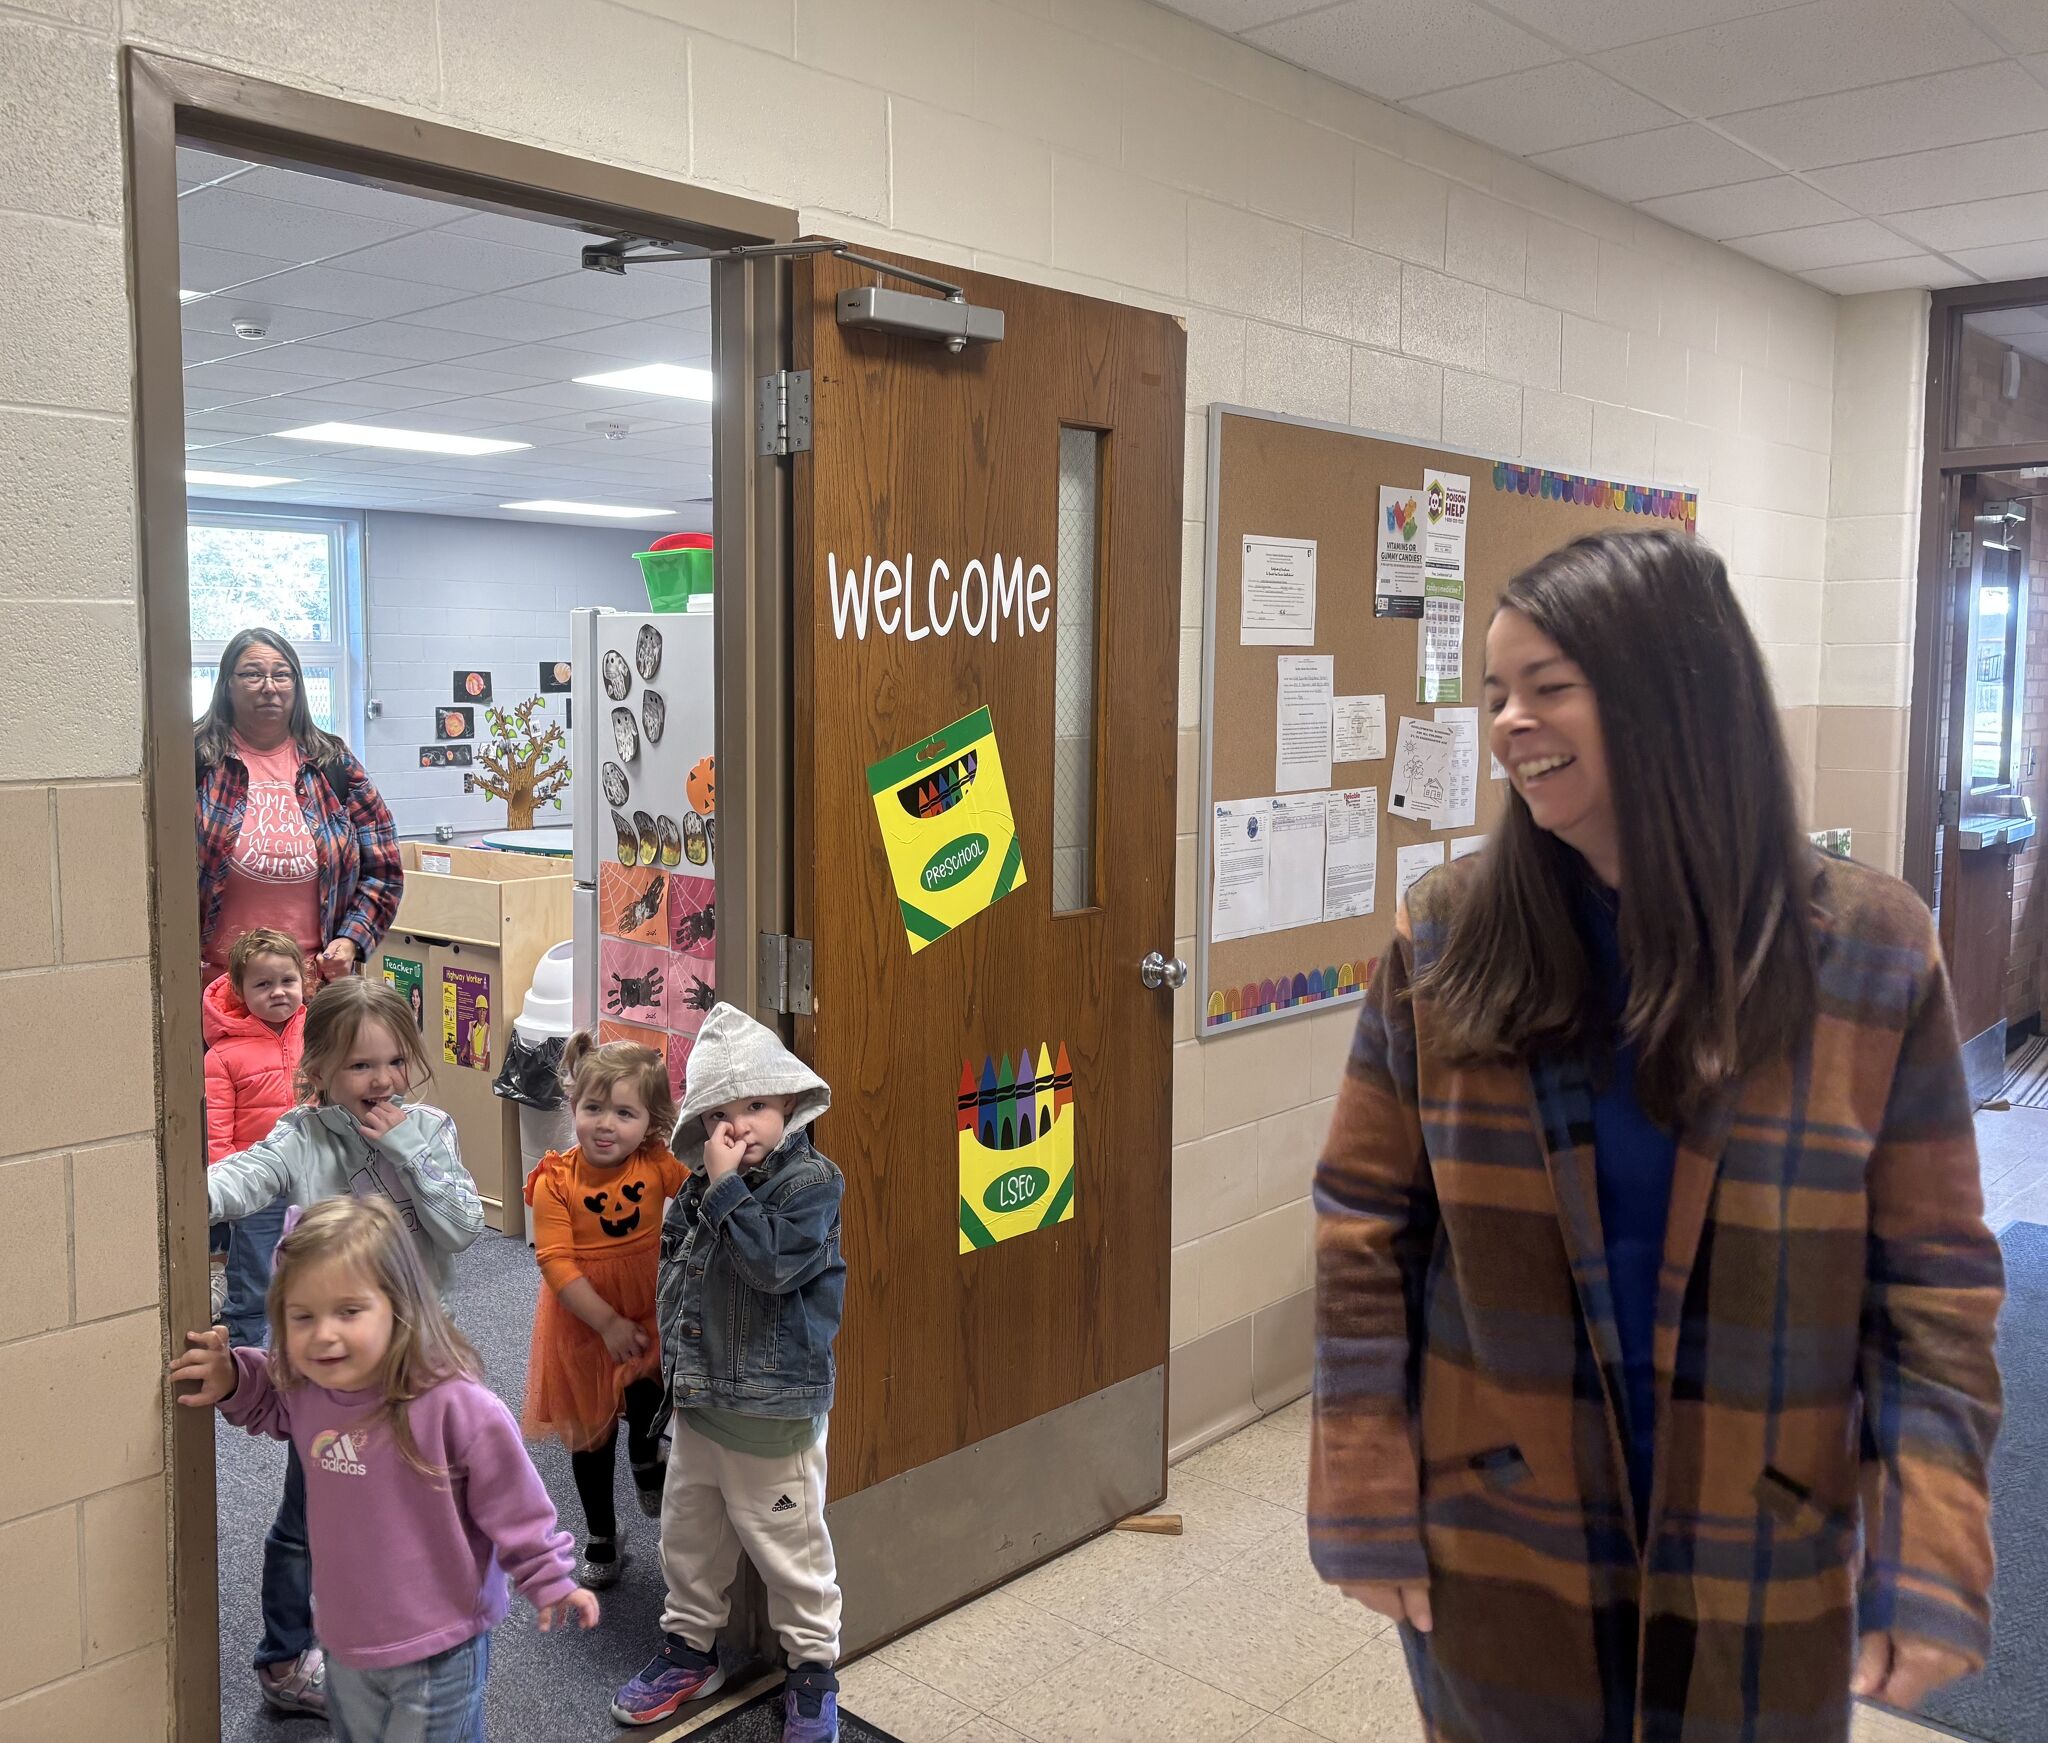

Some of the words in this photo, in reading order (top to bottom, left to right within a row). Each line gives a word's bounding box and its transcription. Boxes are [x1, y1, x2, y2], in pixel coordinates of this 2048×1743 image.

[1446, 493, 1466, 504] POISON
[1445, 503, 1465, 518] HELP
[1387, 542, 1408, 551] VITAMINS
[1381, 552, 1398, 560] GUMMY
[1399, 553, 1422, 562] CANDIES?
[248, 790, 290, 811] SOME
[1344, 792, 1361, 800] Reliable
[249, 835, 272, 853] WE
[240, 847, 318, 877] DAYCARE
[385, 958, 414, 975] Teacher
[445, 969, 465, 983] Highway
[466, 973, 483, 985] Worker
[1000, 1174, 1035, 1207] LSEC
[321, 1458, 367, 1476] adidas
[771, 1502, 797, 1512] adidas
